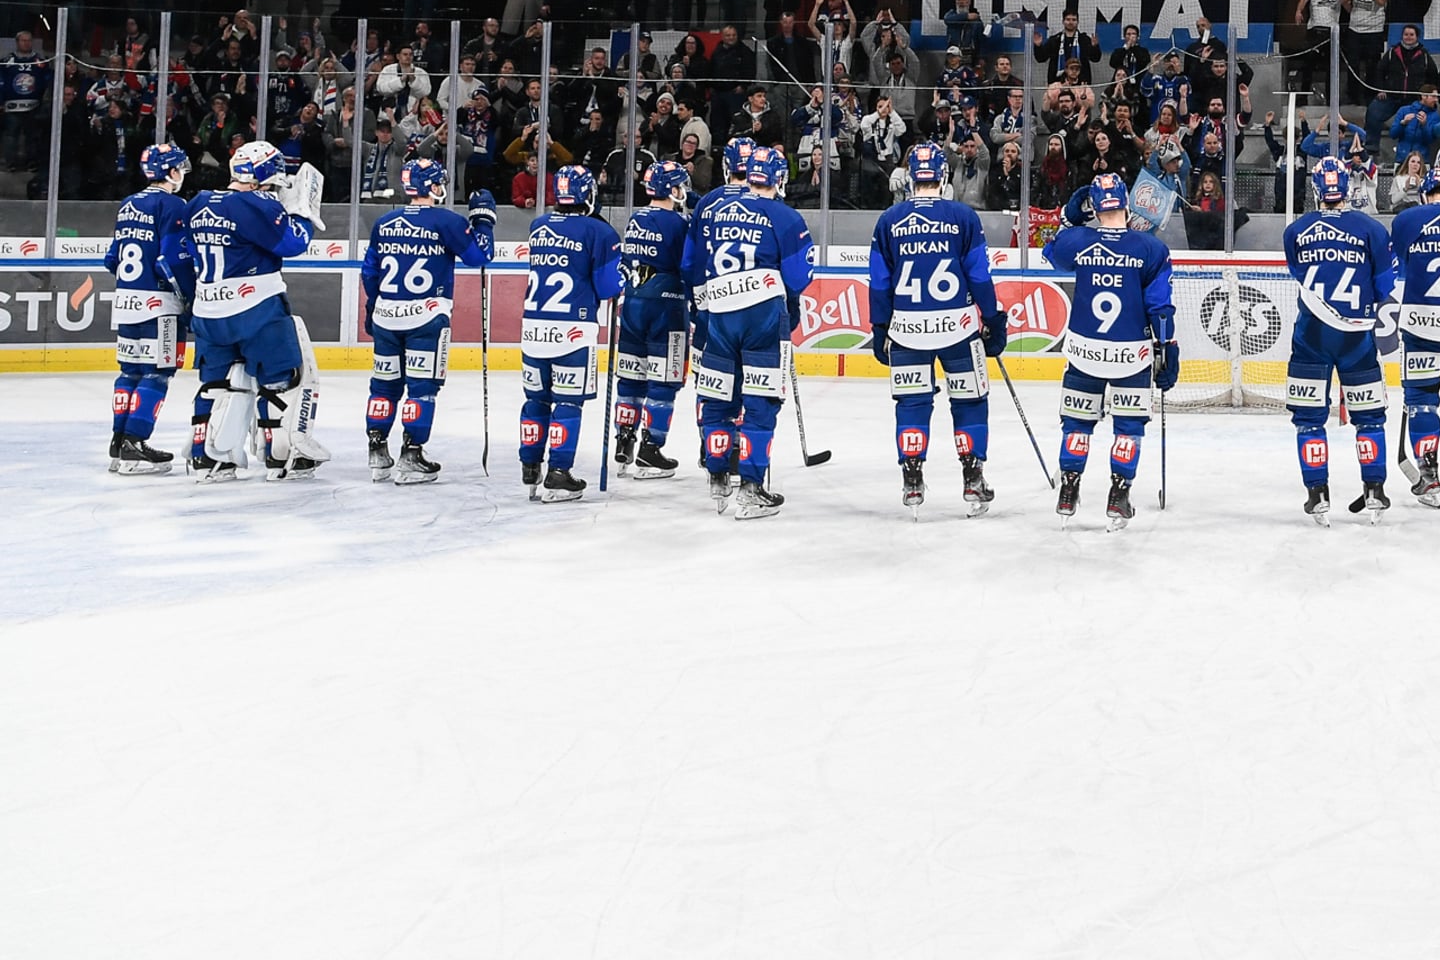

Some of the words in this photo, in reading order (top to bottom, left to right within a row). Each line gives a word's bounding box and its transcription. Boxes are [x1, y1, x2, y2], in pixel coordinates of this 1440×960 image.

[715, 227, 762, 243] LEONE
[900, 241, 949, 255] KUKAN
[1298, 248, 1365, 264] LEHTONEN
[197, 245, 225, 283] 11
[714, 241, 756, 275] 61
[840, 251, 870, 263] Swiss
[380, 256, 433, 294] 26
[895, 259, 960, 303] 46
[1092, 273, 1123, 288] ROE
[1304, 265, 1361, 310] 44
[800, 283, 861, 337] Bell
[1004, 286, 1048, 331] ell
[1091, 291, 1122, 333] 9
[1067, 340, 1136, 364] SwissLife
[619, 359, 641, 372] ewz
[1408, 356, 1436, 369] ewz
[552, 371, 575, 384] ewz
[699, 373, 723, 389] ewz
[745, 373, 769, 387] ewz
[894, 370, 922, 384] ewz
[1289, 383, 1317, 398] ewz
[1347, 389, 1374, 402] ewz
[1064, 394, 1093, 410] ewz
[1113, 393, 1141, 407] ewz
[298, 389, 312, 434] VAUGHN
